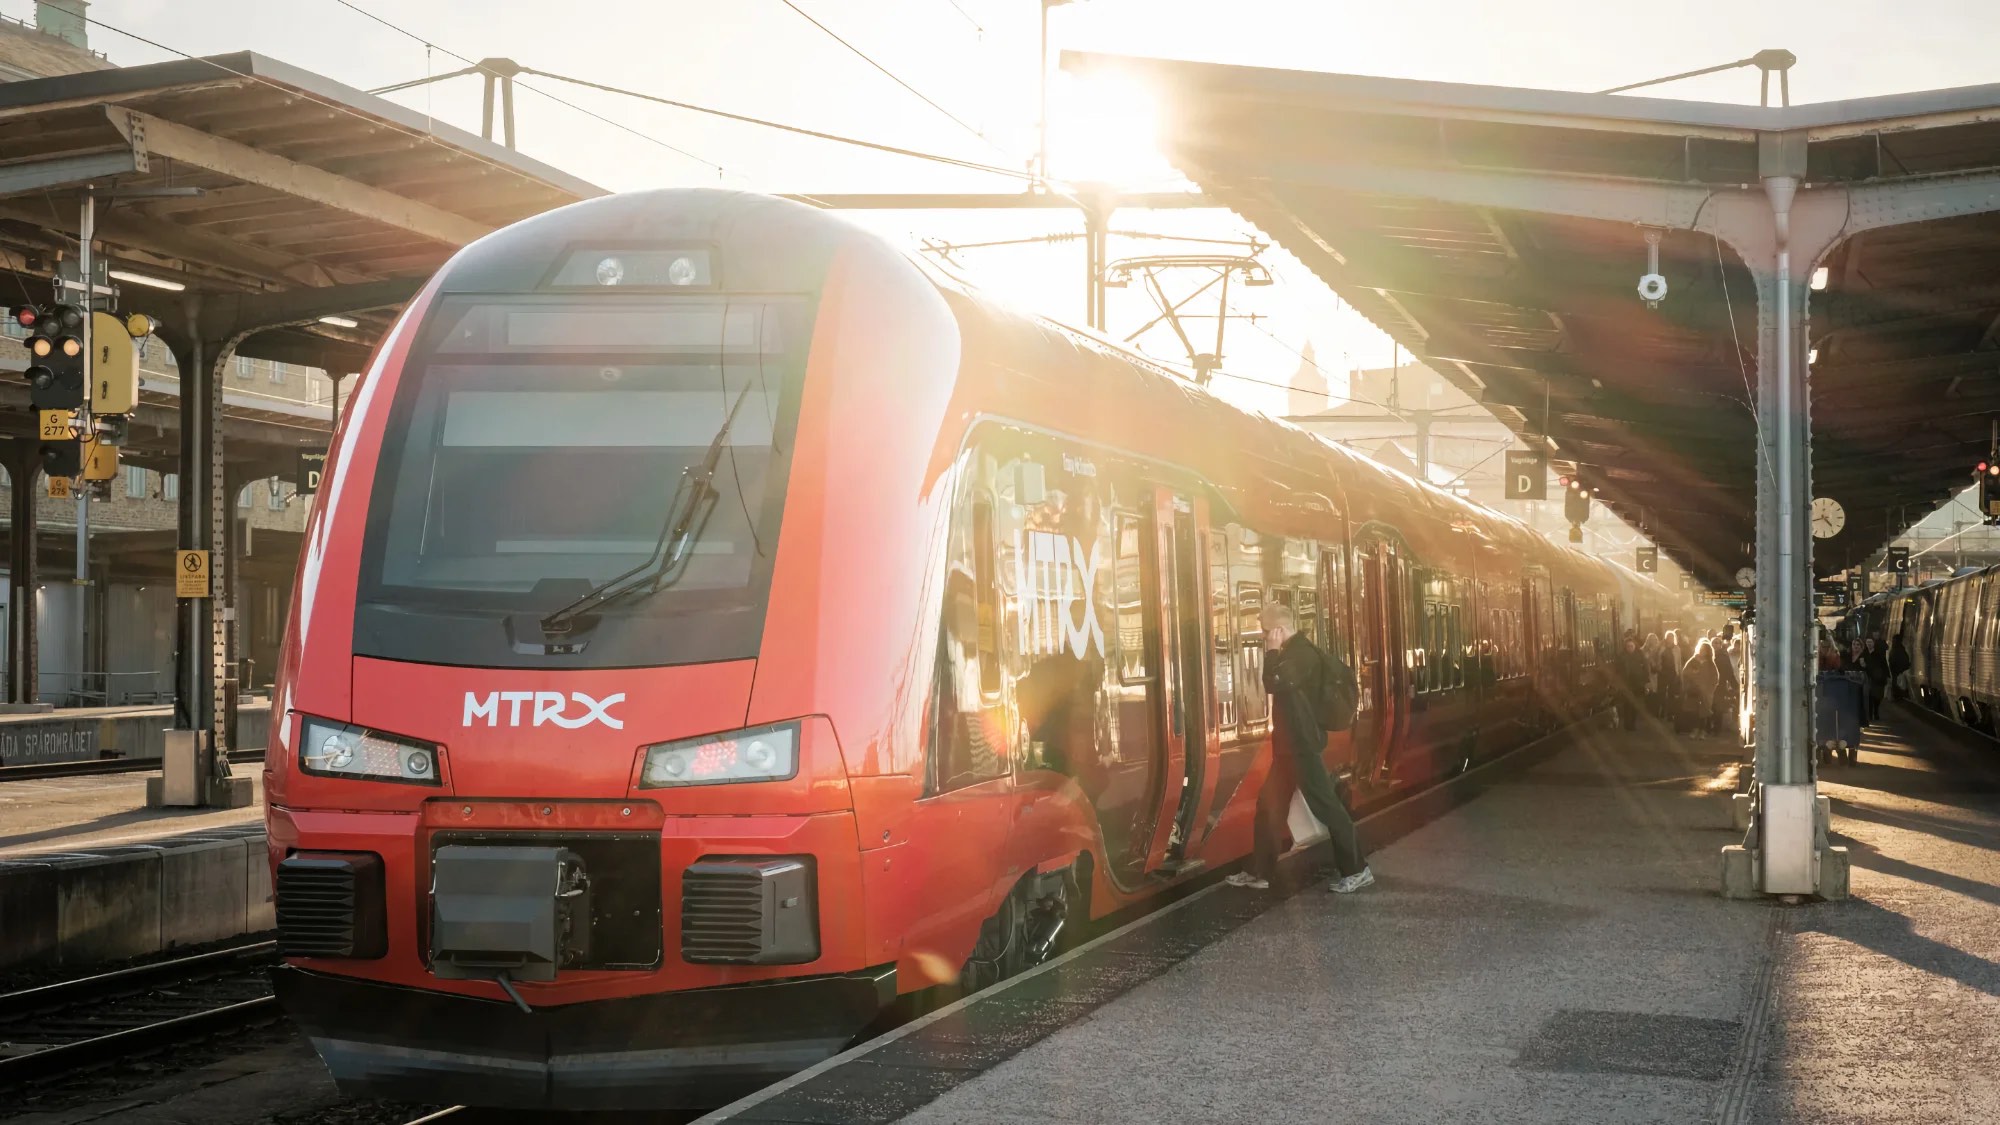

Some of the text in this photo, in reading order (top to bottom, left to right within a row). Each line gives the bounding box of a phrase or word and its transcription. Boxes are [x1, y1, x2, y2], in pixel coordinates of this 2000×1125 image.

[50, 414, 58, 424] G
[44, 426, 65, 436] 277
[308, 470, 321, 489] D
[1518, 474, 1532, 493] D
[1642, 559, 1650, 570] C
[1896, 559, 1903, 570] C
[462, 691, 626, 730] MTRX
